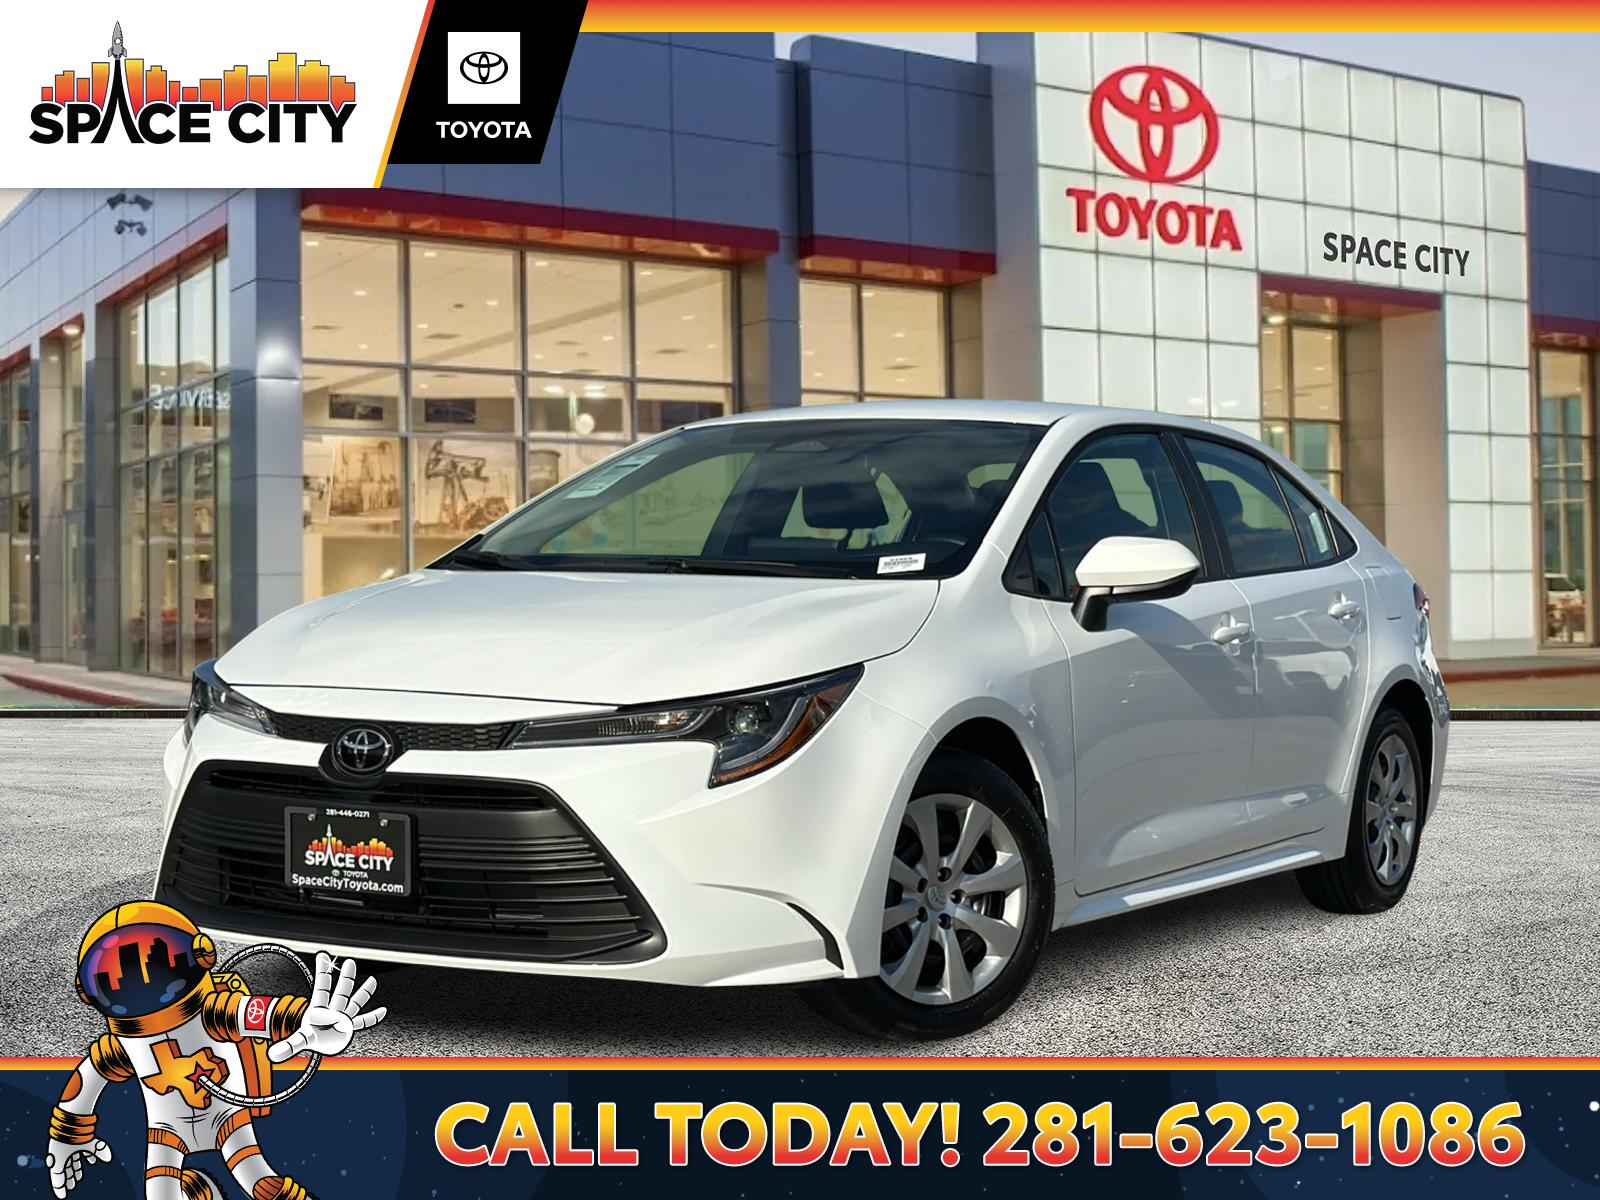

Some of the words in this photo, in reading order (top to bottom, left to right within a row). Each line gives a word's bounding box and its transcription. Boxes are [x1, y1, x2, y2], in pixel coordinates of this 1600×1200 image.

[1066, 187, 1242, 251] TOYOTA
[1323, 231, 1407, 270] SPACE
[1414, 243, 1470, 277] CITY
[325, 808, 370, 819] 281-446-0271
[304, 849, 356, 868] SPACE
[358, 854, 394, 871] CITY
[291, 873, 404, 894] SpaceCityToyota.com
[343, 870, 368, 879] TOYOTA
